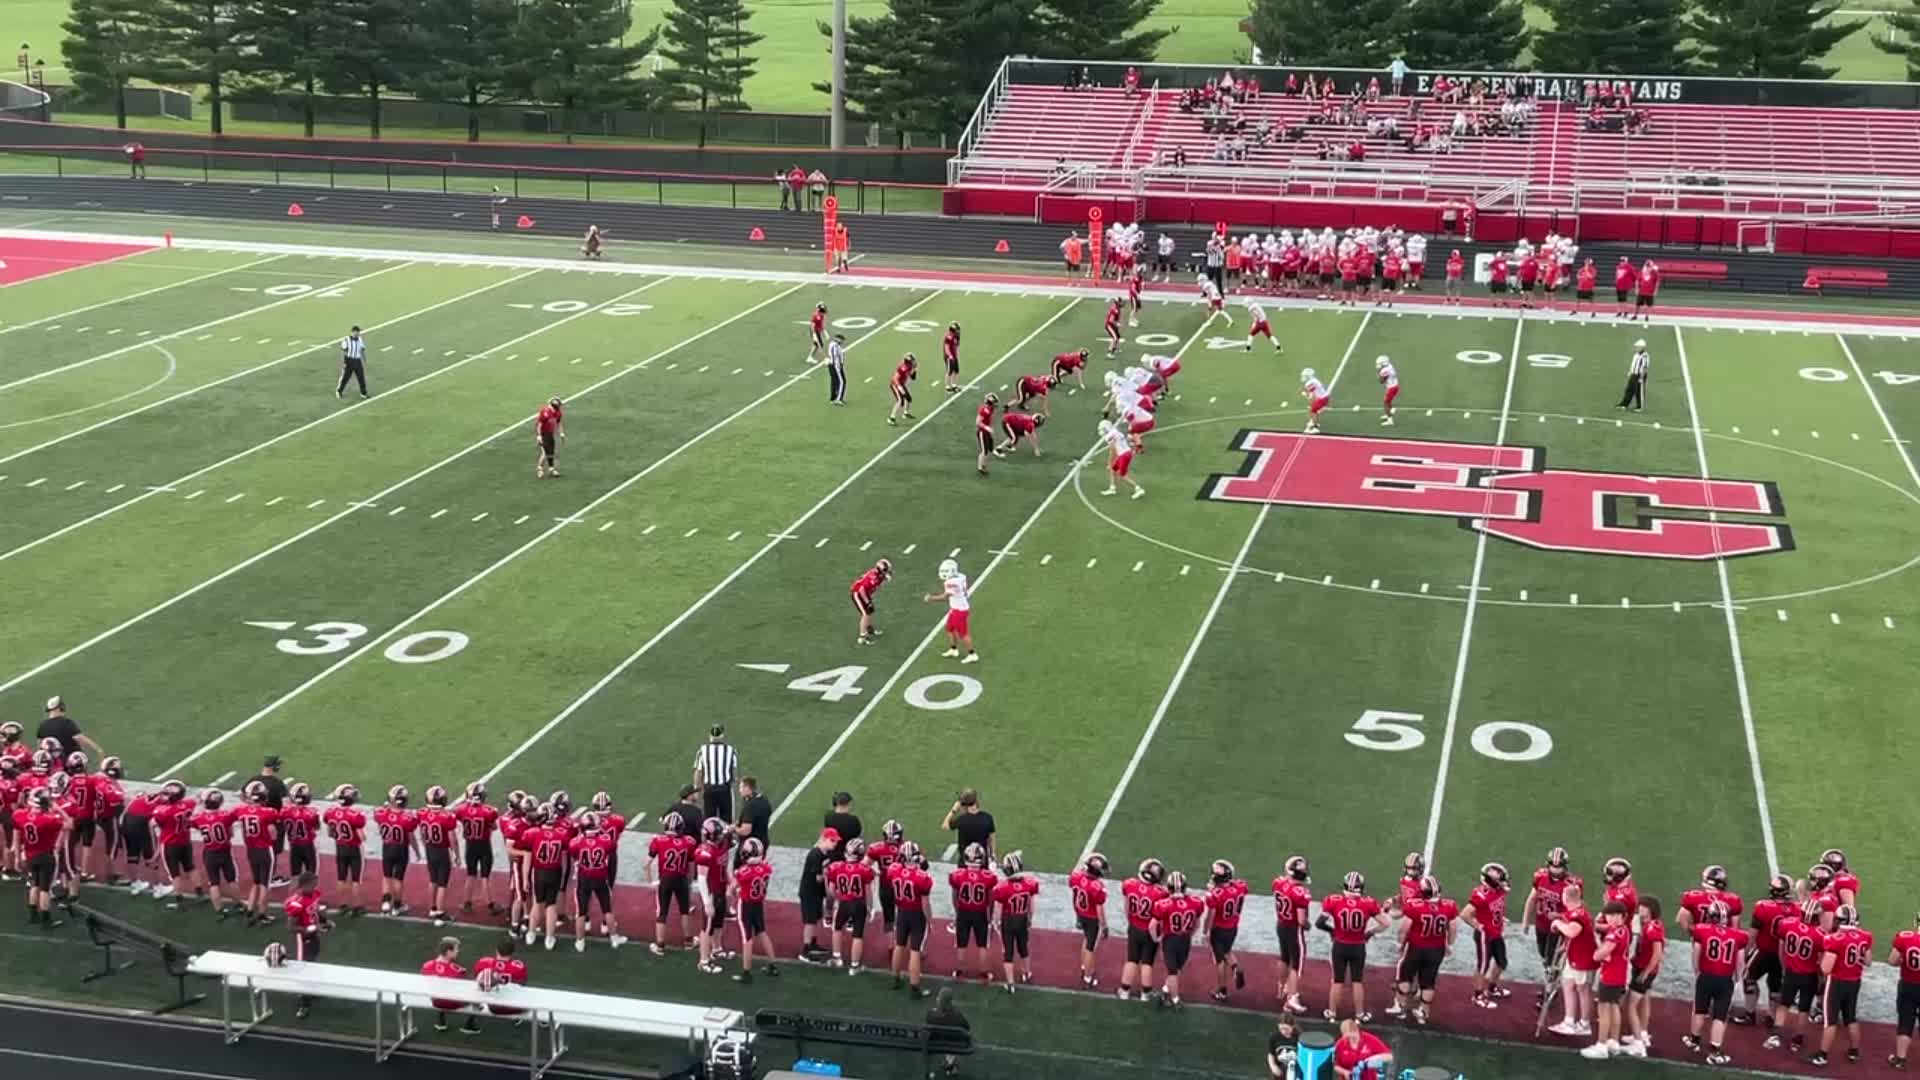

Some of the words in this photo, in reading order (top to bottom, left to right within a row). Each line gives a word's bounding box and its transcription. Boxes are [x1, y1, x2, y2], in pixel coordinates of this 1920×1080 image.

[1418, 76, 1472, 94] EST
[24, 823, 39, 845] 8
[238, 815, 260, 839] 15
[536, 840, 562, 864] 47
[579, 846, 605, 870] 42
[663, 848, 688, 872] 21
[836, 874, 862, 897] 84
[892, 878, 915, 902] 14
[959, 882, 985, 905] 46
[1008, 892, 1029, 914] 17
[1128, 894, 1152, 919] 62
[1170, 911, 1196, 933] 92
[1338, 909, 1366, 932] 10
[1421, 914, 1447, 938] 76
[1706, 938, 1736, 964] 81
[1784, 934, 1814, 960] 86
